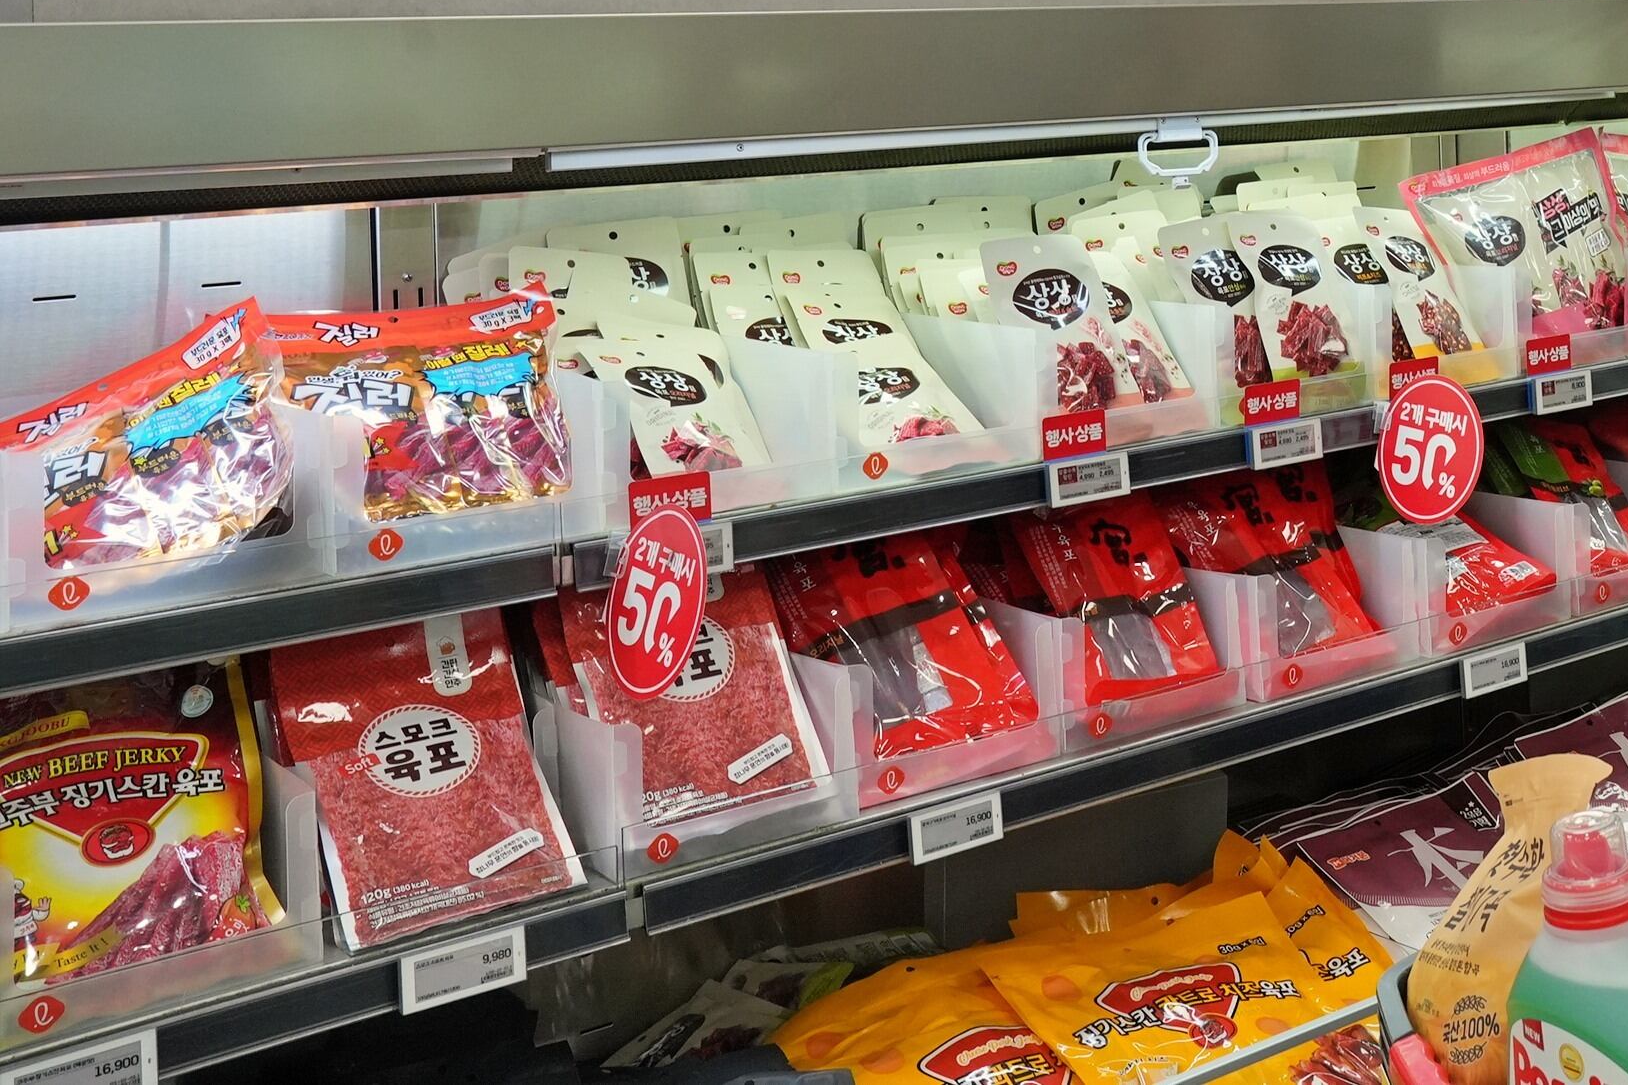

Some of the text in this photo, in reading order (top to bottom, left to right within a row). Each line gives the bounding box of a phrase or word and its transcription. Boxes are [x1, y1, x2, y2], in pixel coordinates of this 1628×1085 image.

[313, 320, 381, 347] 질러
[639, 371, 690, 391] 상상
[17, 401, 89, 444] 질러
[1400, 401, 1469, 435] 2개 구매시
[635, 536, 696, 587] 2개 구매시
[440, 657, 459, 670] 간편
[443, 678, 462, 690] 안주
[374, 717, 458, 751] 스모크
[3, 744, 186, 789] NEW BEEF JERKY
[344, 757, 375, 776] Soft
[383, 740, 467, 783] 육포
[63, 771, 170, 809] 징기스칸
[172, 767, 225, 797] 육포
[641, 790, 662, 804] 20g
[965, 810, 992, 826] 16,900
[360, 878, 430, 905] 120g (380 kcal)
[55, 949, 88, 970] Taste
[482, 947, 512, 965] 9,980
[1218, 944, 1241, 954] 30g
[1329, 947, 1370, 979] 육포
[1071, 1004, 1157, 1050] 징기스칸
[1524, 1024, 1542, 1044] NEW
[95, 1053, 140, 1078] 16,900
